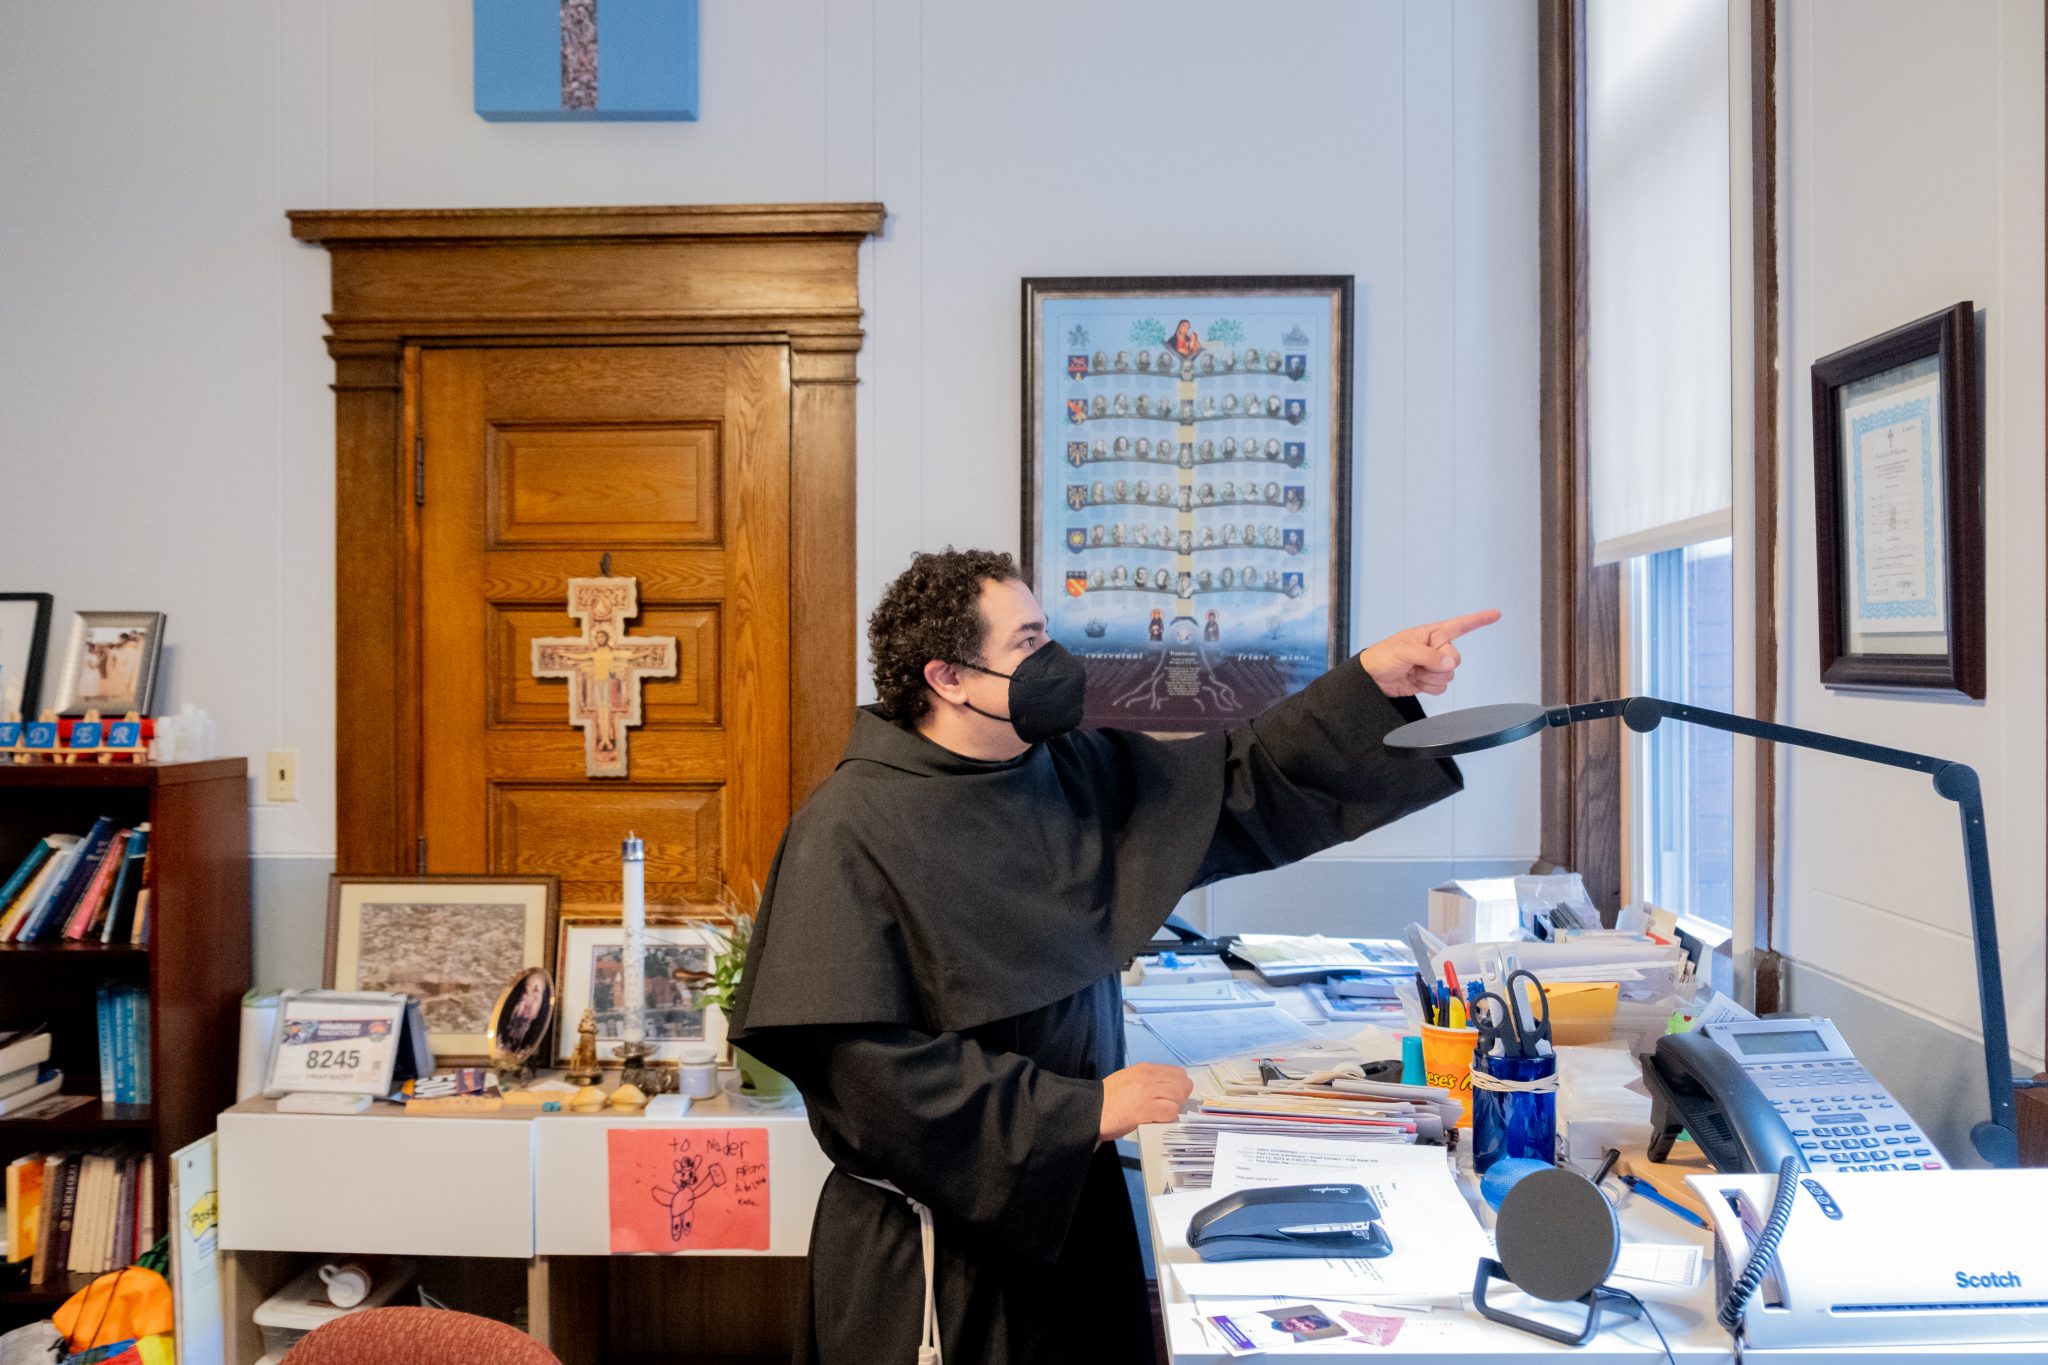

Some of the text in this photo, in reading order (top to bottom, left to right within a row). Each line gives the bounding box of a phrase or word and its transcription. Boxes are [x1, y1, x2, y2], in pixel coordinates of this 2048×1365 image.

[1238, 653, 1270, 661] friars
[306, 1050, 360, 1069] 8245
[1427, 1072, 1457, 1089] ese's
[191, 1203, 218, 1229] Post
[1955, 1271, 2022, 1288] Scotch
